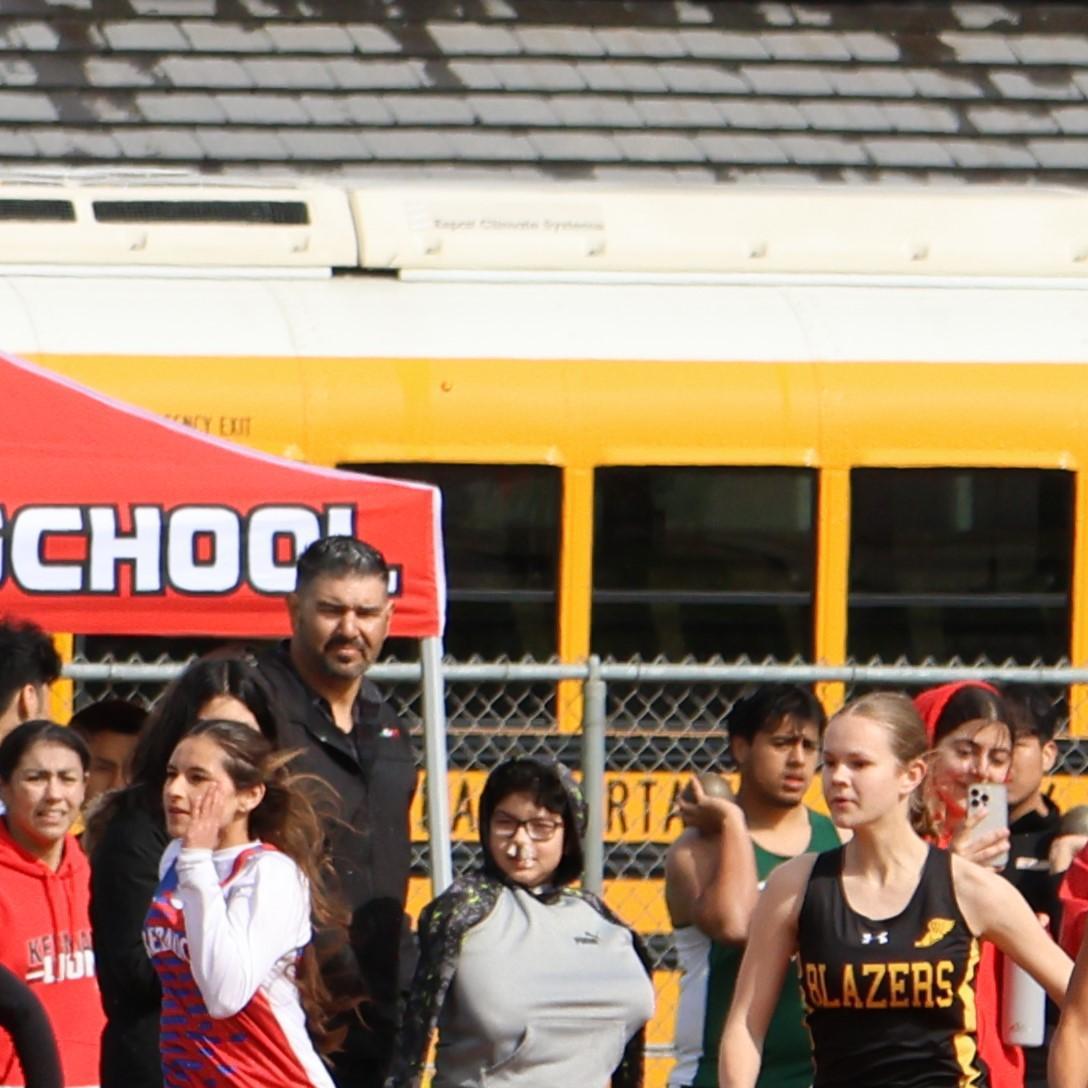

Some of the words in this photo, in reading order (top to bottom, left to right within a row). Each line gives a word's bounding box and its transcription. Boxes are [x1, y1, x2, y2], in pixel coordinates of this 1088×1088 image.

[219, 414, 252, 438] EXIT
[0, 502, 403, 598] CHOO
[804, 960, 955, 1009] BLAZERS
